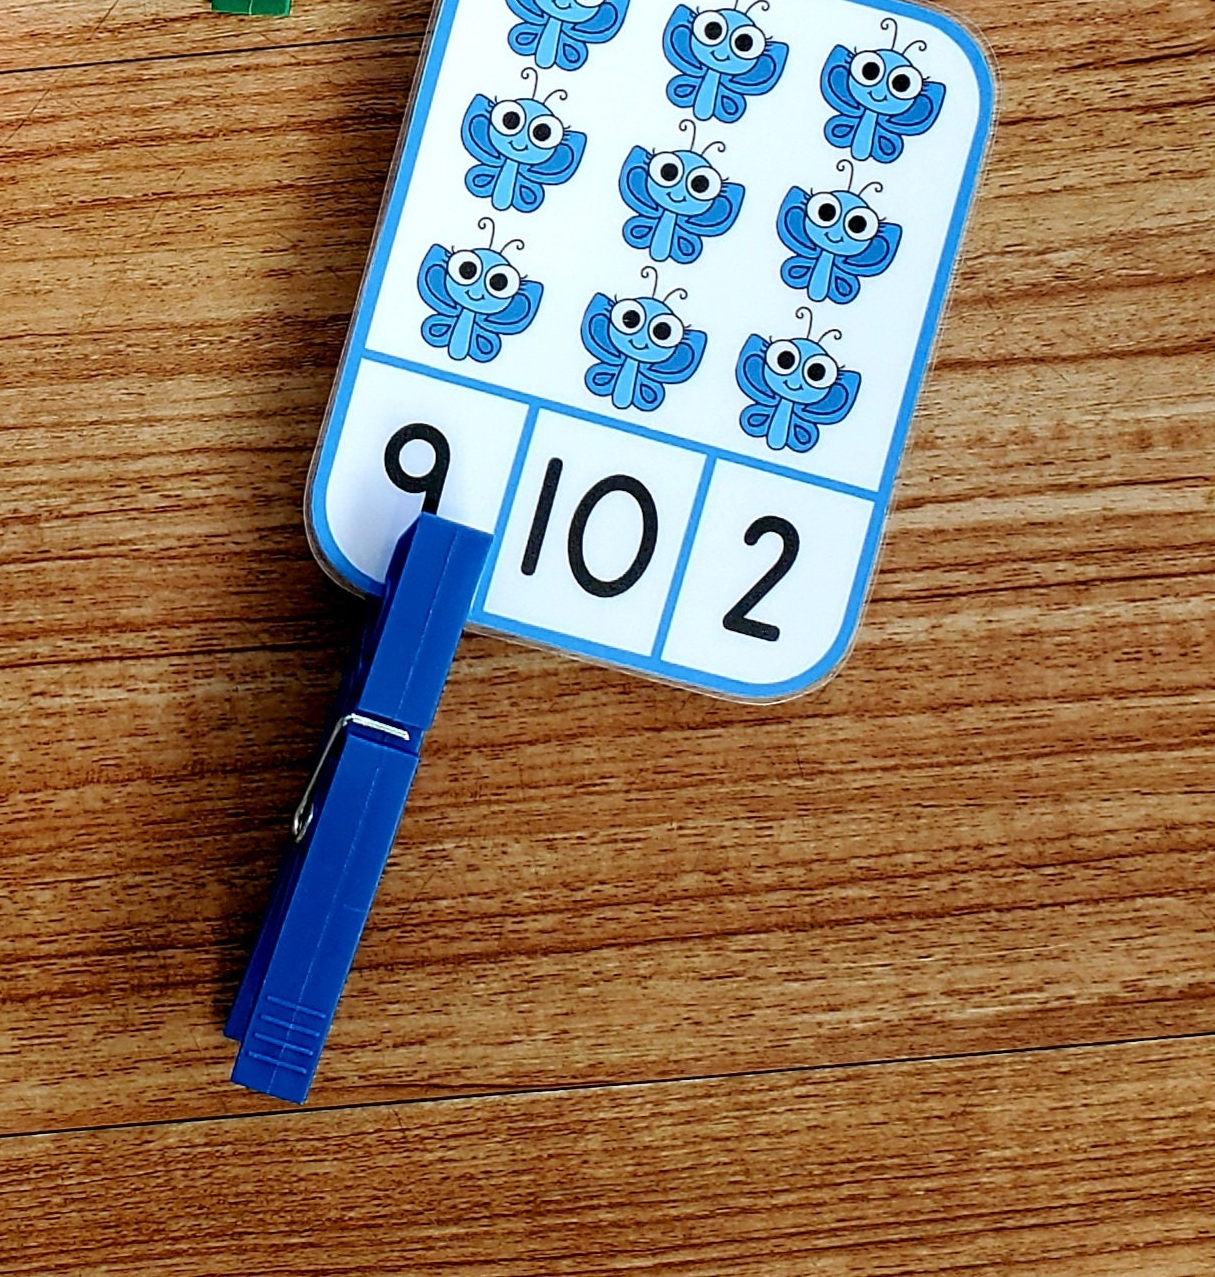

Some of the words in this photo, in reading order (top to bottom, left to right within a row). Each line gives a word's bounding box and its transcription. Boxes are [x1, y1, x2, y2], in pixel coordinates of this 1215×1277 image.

[384, 423, 451, 515] 9
[520, 457, 658, 598] 10
[722, 515, 800, 642] 2
